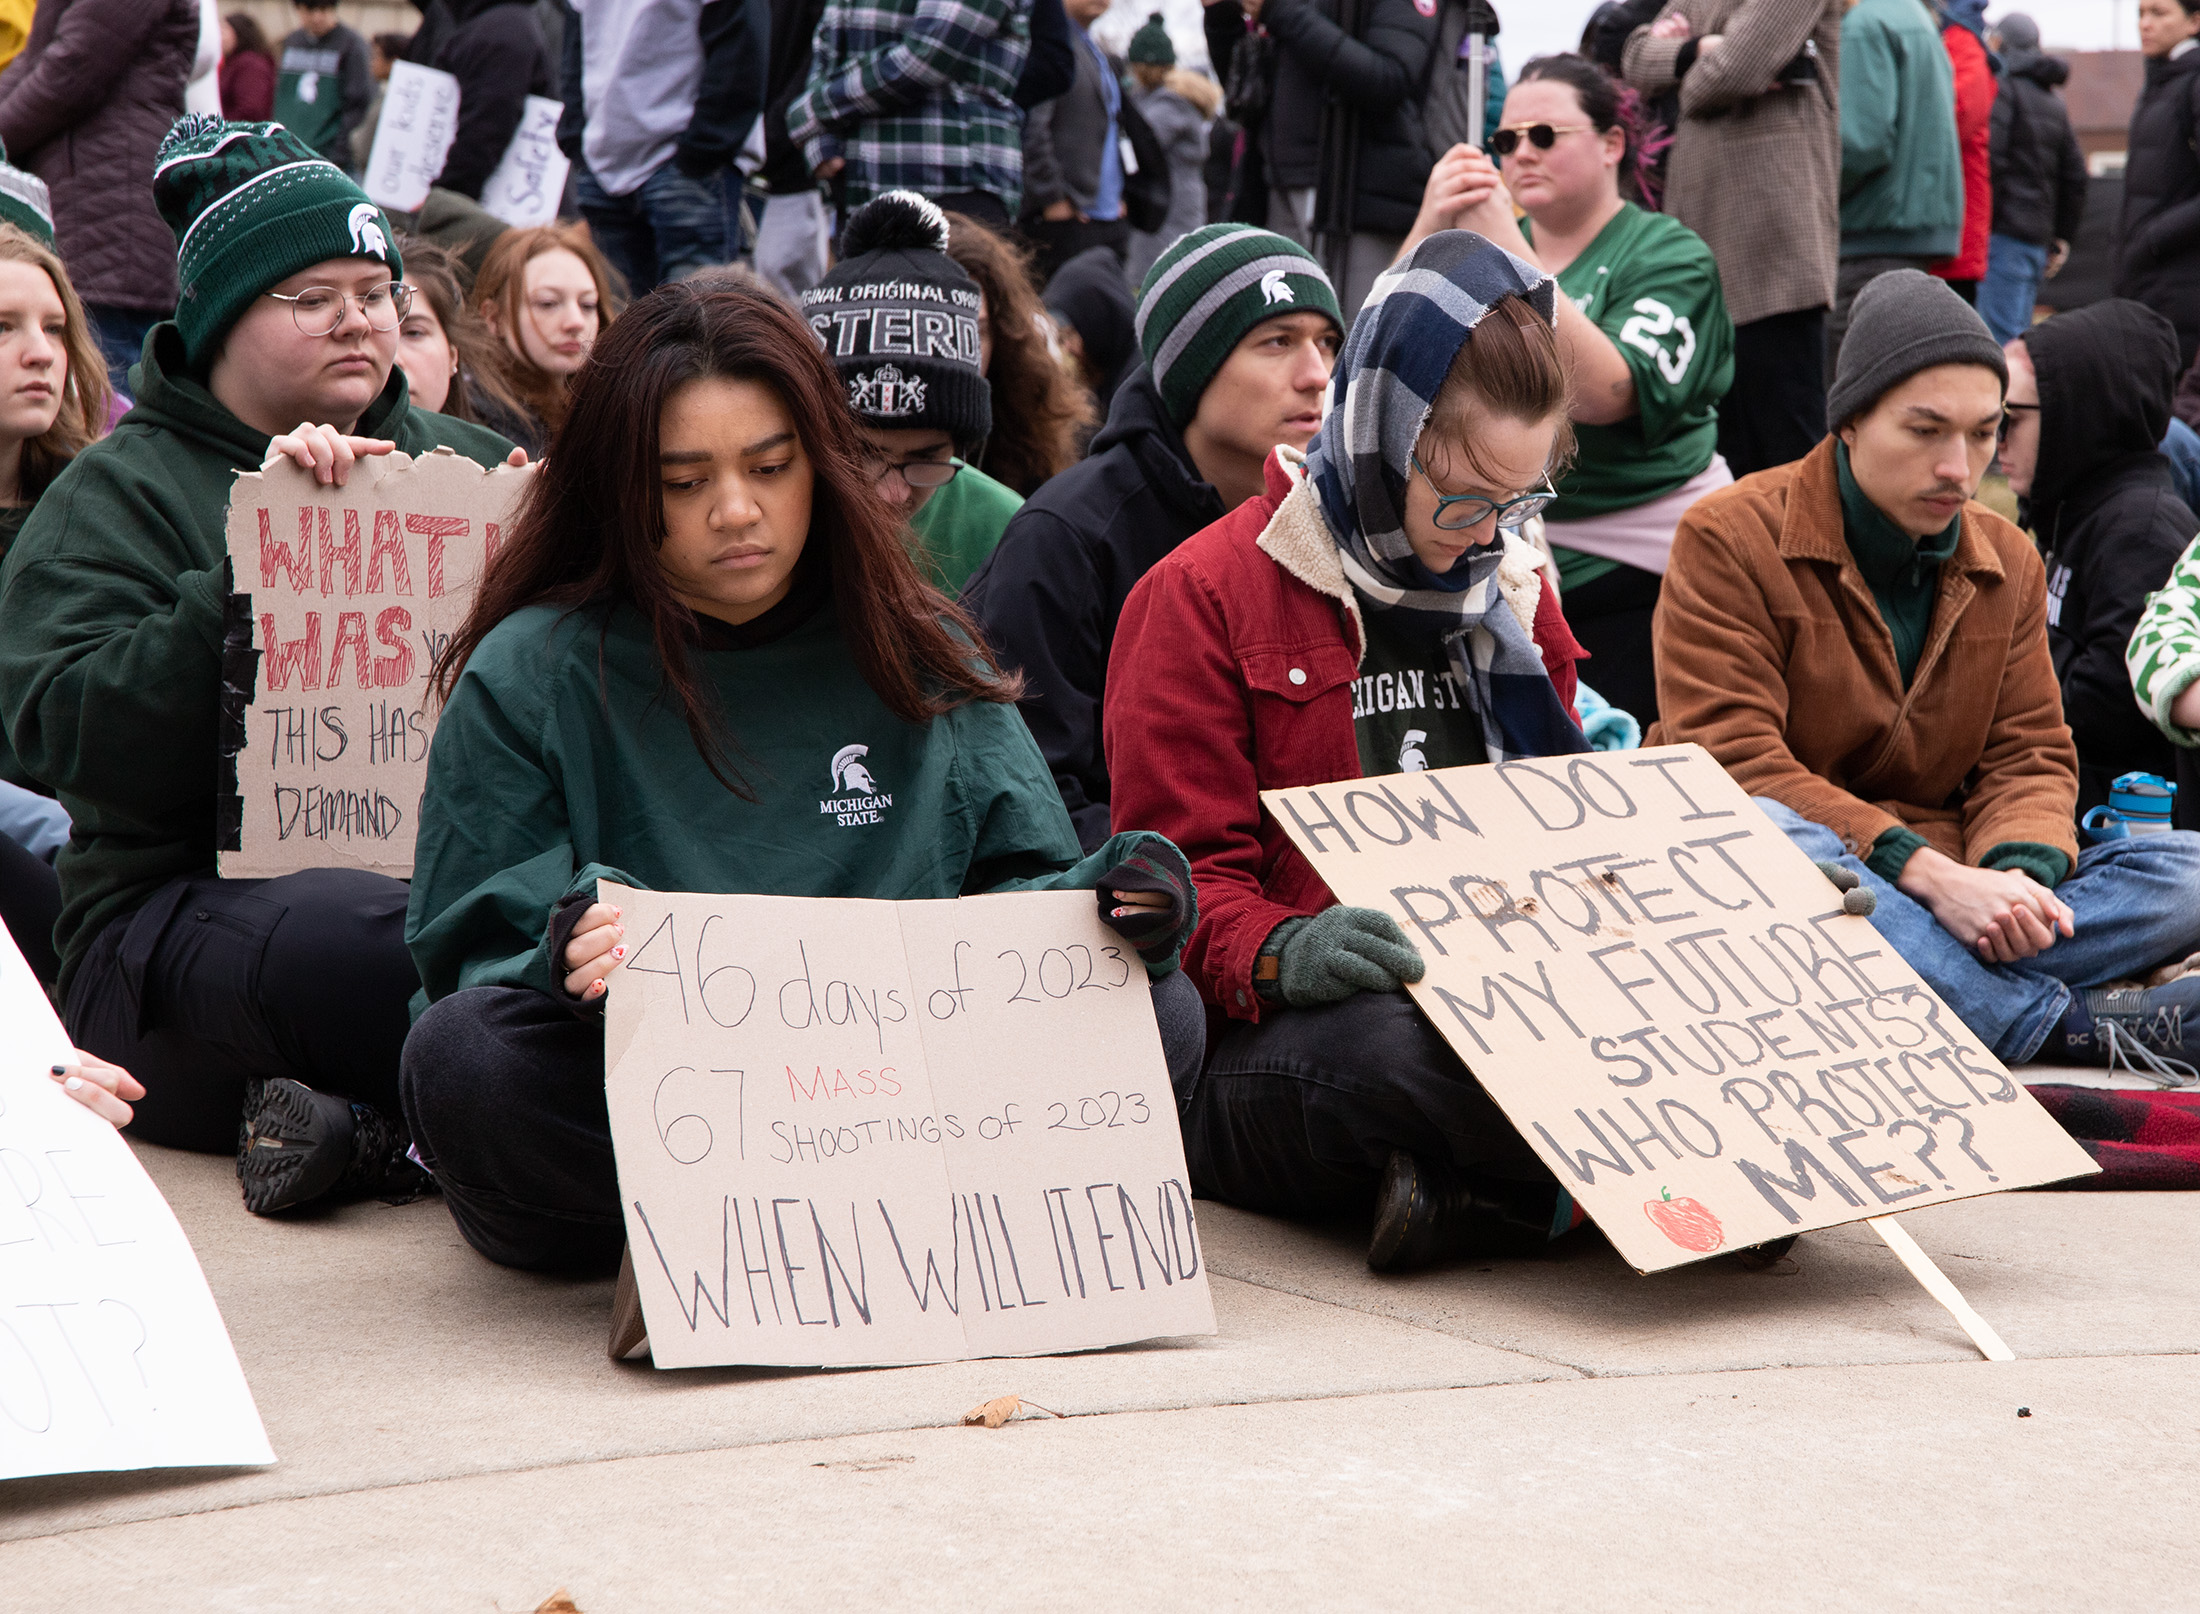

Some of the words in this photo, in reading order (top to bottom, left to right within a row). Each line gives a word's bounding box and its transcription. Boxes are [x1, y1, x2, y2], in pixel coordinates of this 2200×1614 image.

[506, 111, 556, 214] Safety
[849, 281, 949, 304] ORIGINAL
[1620, 297, 1696, 385] 23
[257, 506, 469, 600] WHAT
[260, 606, 415, 692] WAS
[263, 706, 348, 771] THIS
[369, 699, 428, 765] HAS
[273, 782, 402, 841] DEMAND
[819, 794, 893, 814] MICHIGAN
[836, 810, 880, 827] STATE
[1280, 774, 1484, 853] HOW
[1494, 759, 1637, 831] DO
[1629, 756, 1736, 822] I
[1390, 830, 1776, 957] PROTECT
[627, 913, 755, 1028] 46
[779, 939, 907, 1054] days
[928, 940, 974, 1020] of
[998, 944, 1129, 1003] 2023
[1431, 960, 1587, 1055] MY
[1587, 910, 1918, 1021] FUTURE
[1591, 987, 1958, 1086] STUDENTS?
[653, 1066, 745, 1164] 67
[786, 1065, 902, 1102] MASS
[770, 1113, 965, 1163] SHOOTINGS
[1048, 1091, 1151, 1131] 2023
[1532, 1097, 1723, 1185] WHO
[1721, 1045, 2018, 1145] PROTECTS
[1733, 1108, 2001, 1225] ME??
[635, 1196, 872, 1332] WHEN
[878, 1193, 1047, 1316] WILL
